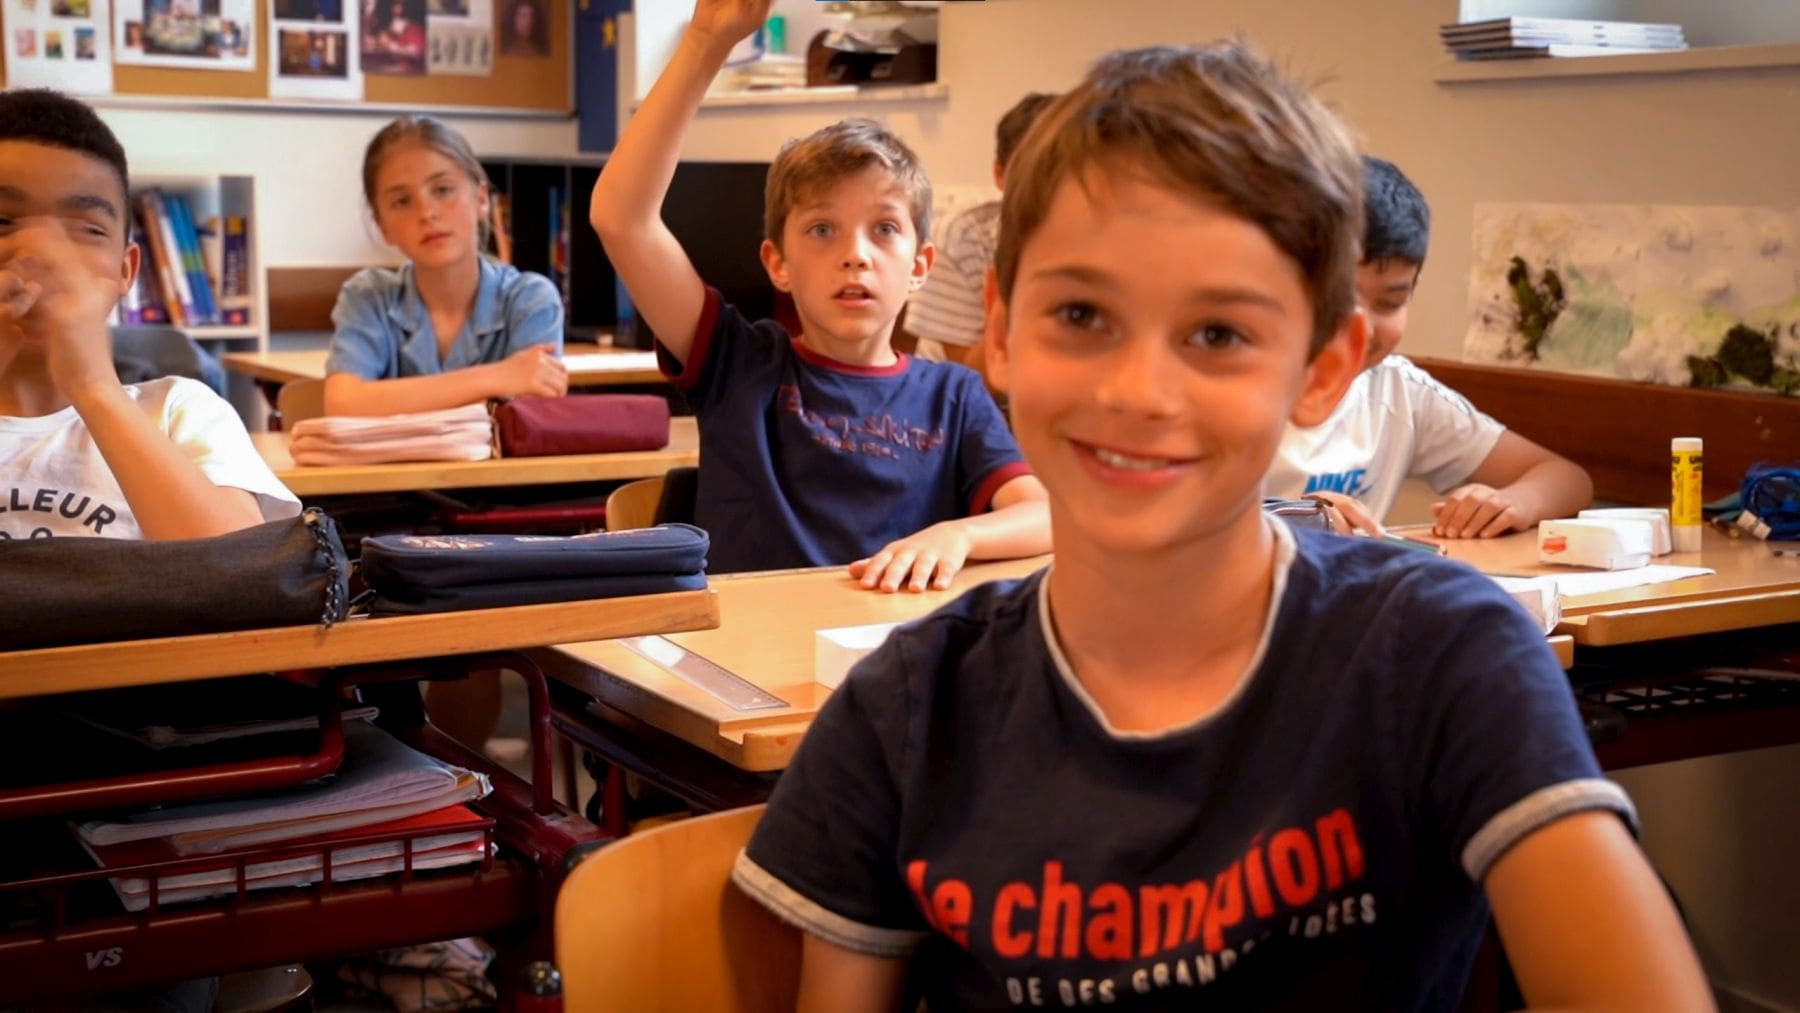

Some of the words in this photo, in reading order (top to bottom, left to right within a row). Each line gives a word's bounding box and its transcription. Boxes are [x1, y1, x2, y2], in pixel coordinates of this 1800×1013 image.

[1303, 468, 1367, 495] NIKE
[992, 808, 1366, 960] champion
[86, 946, 123, 970] VS
[1006, 976, 1044, 1007] DE
[1131, 932, 1271, 995] GRAND
